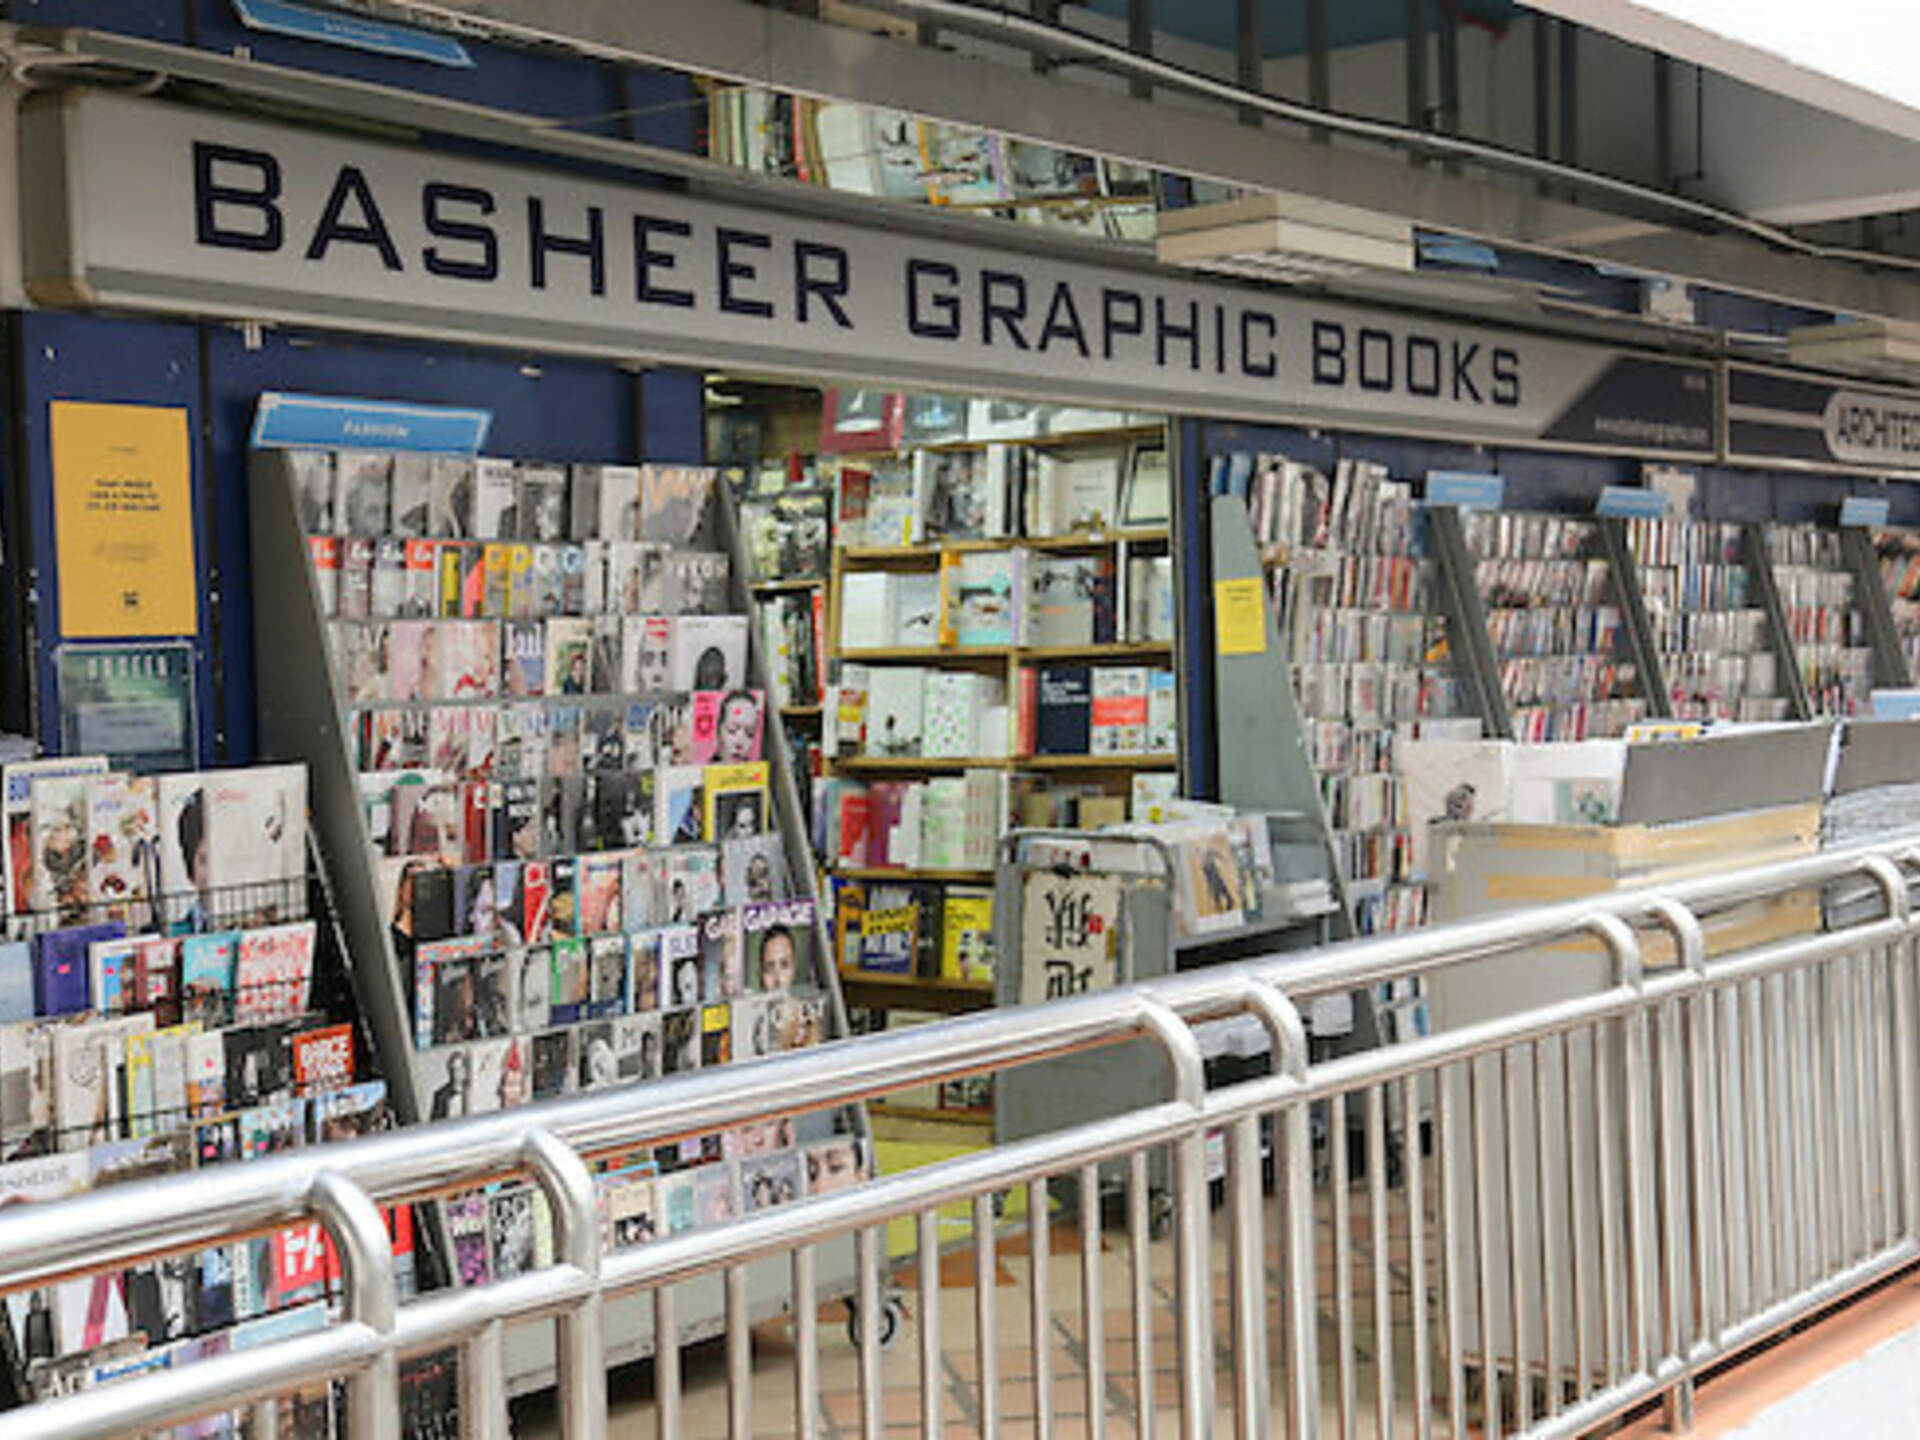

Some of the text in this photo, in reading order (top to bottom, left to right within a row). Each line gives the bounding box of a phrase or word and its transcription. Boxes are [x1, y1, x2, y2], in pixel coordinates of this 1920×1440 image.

[192, 140, 1522, 407] BASHEER GRAPHIC BOOKS
